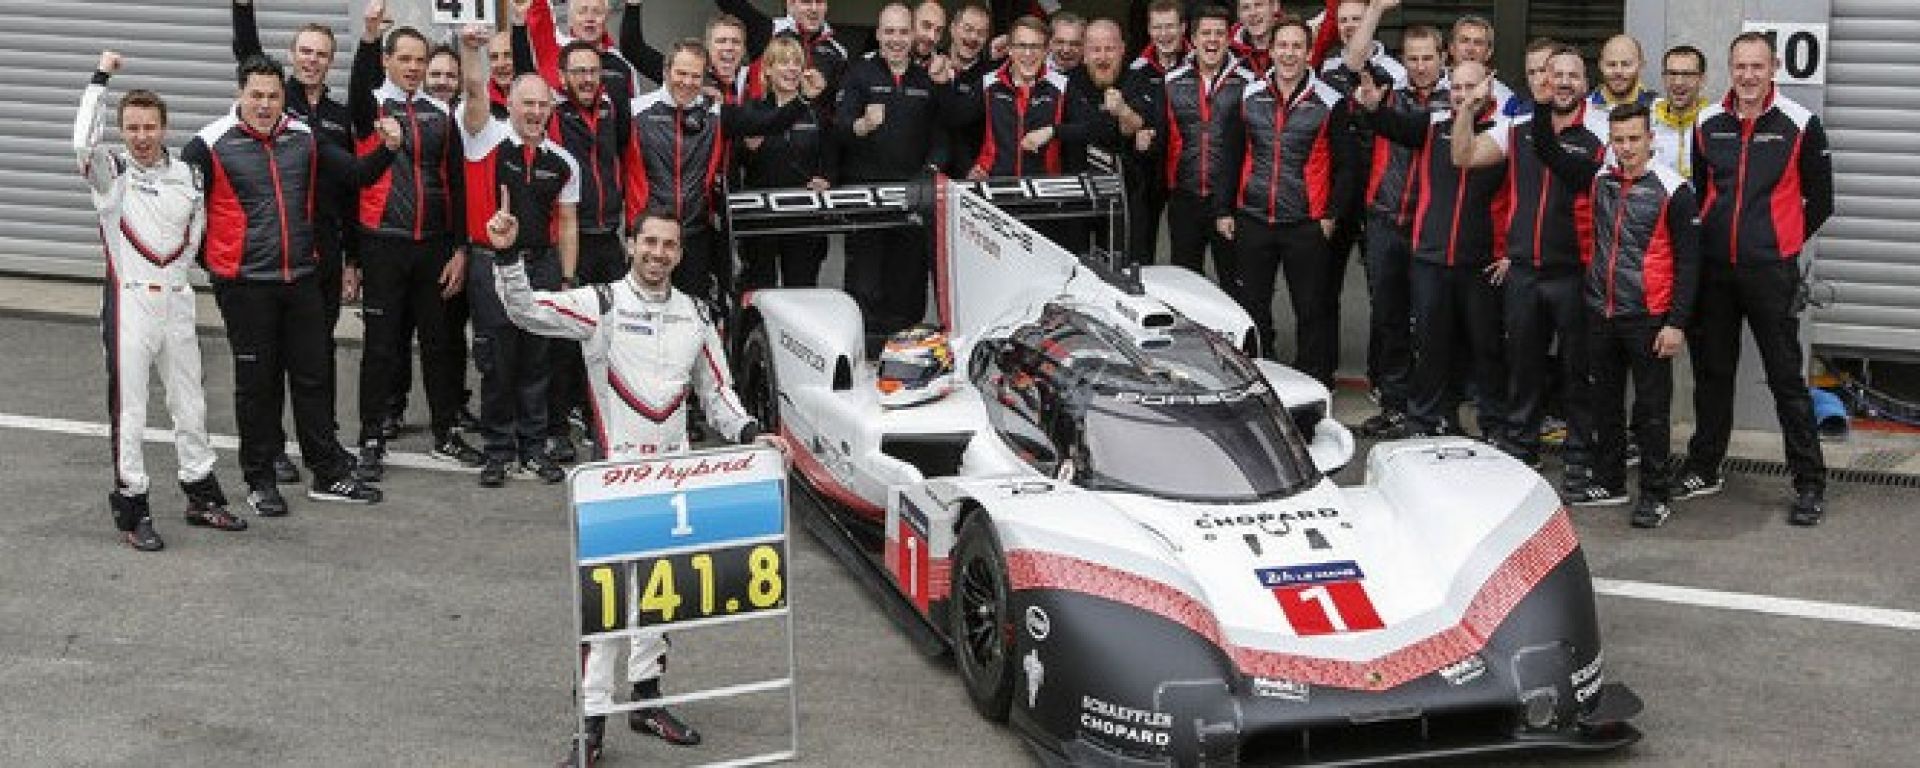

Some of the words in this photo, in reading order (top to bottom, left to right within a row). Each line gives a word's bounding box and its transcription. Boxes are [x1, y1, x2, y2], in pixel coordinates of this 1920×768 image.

[1116, 382, 1268, 404] PORSC
[602, 464, 652, 487] 919
[657, 453, 755, 488] hybrid
[671, 493, 693, 536] 1
[591, 545, 782, 631] 141.8
[907, 537, 918, 598] 1
[1298, 586, 1349, 632] 1
[1081, 713, 1172, 746] CHOPARD
